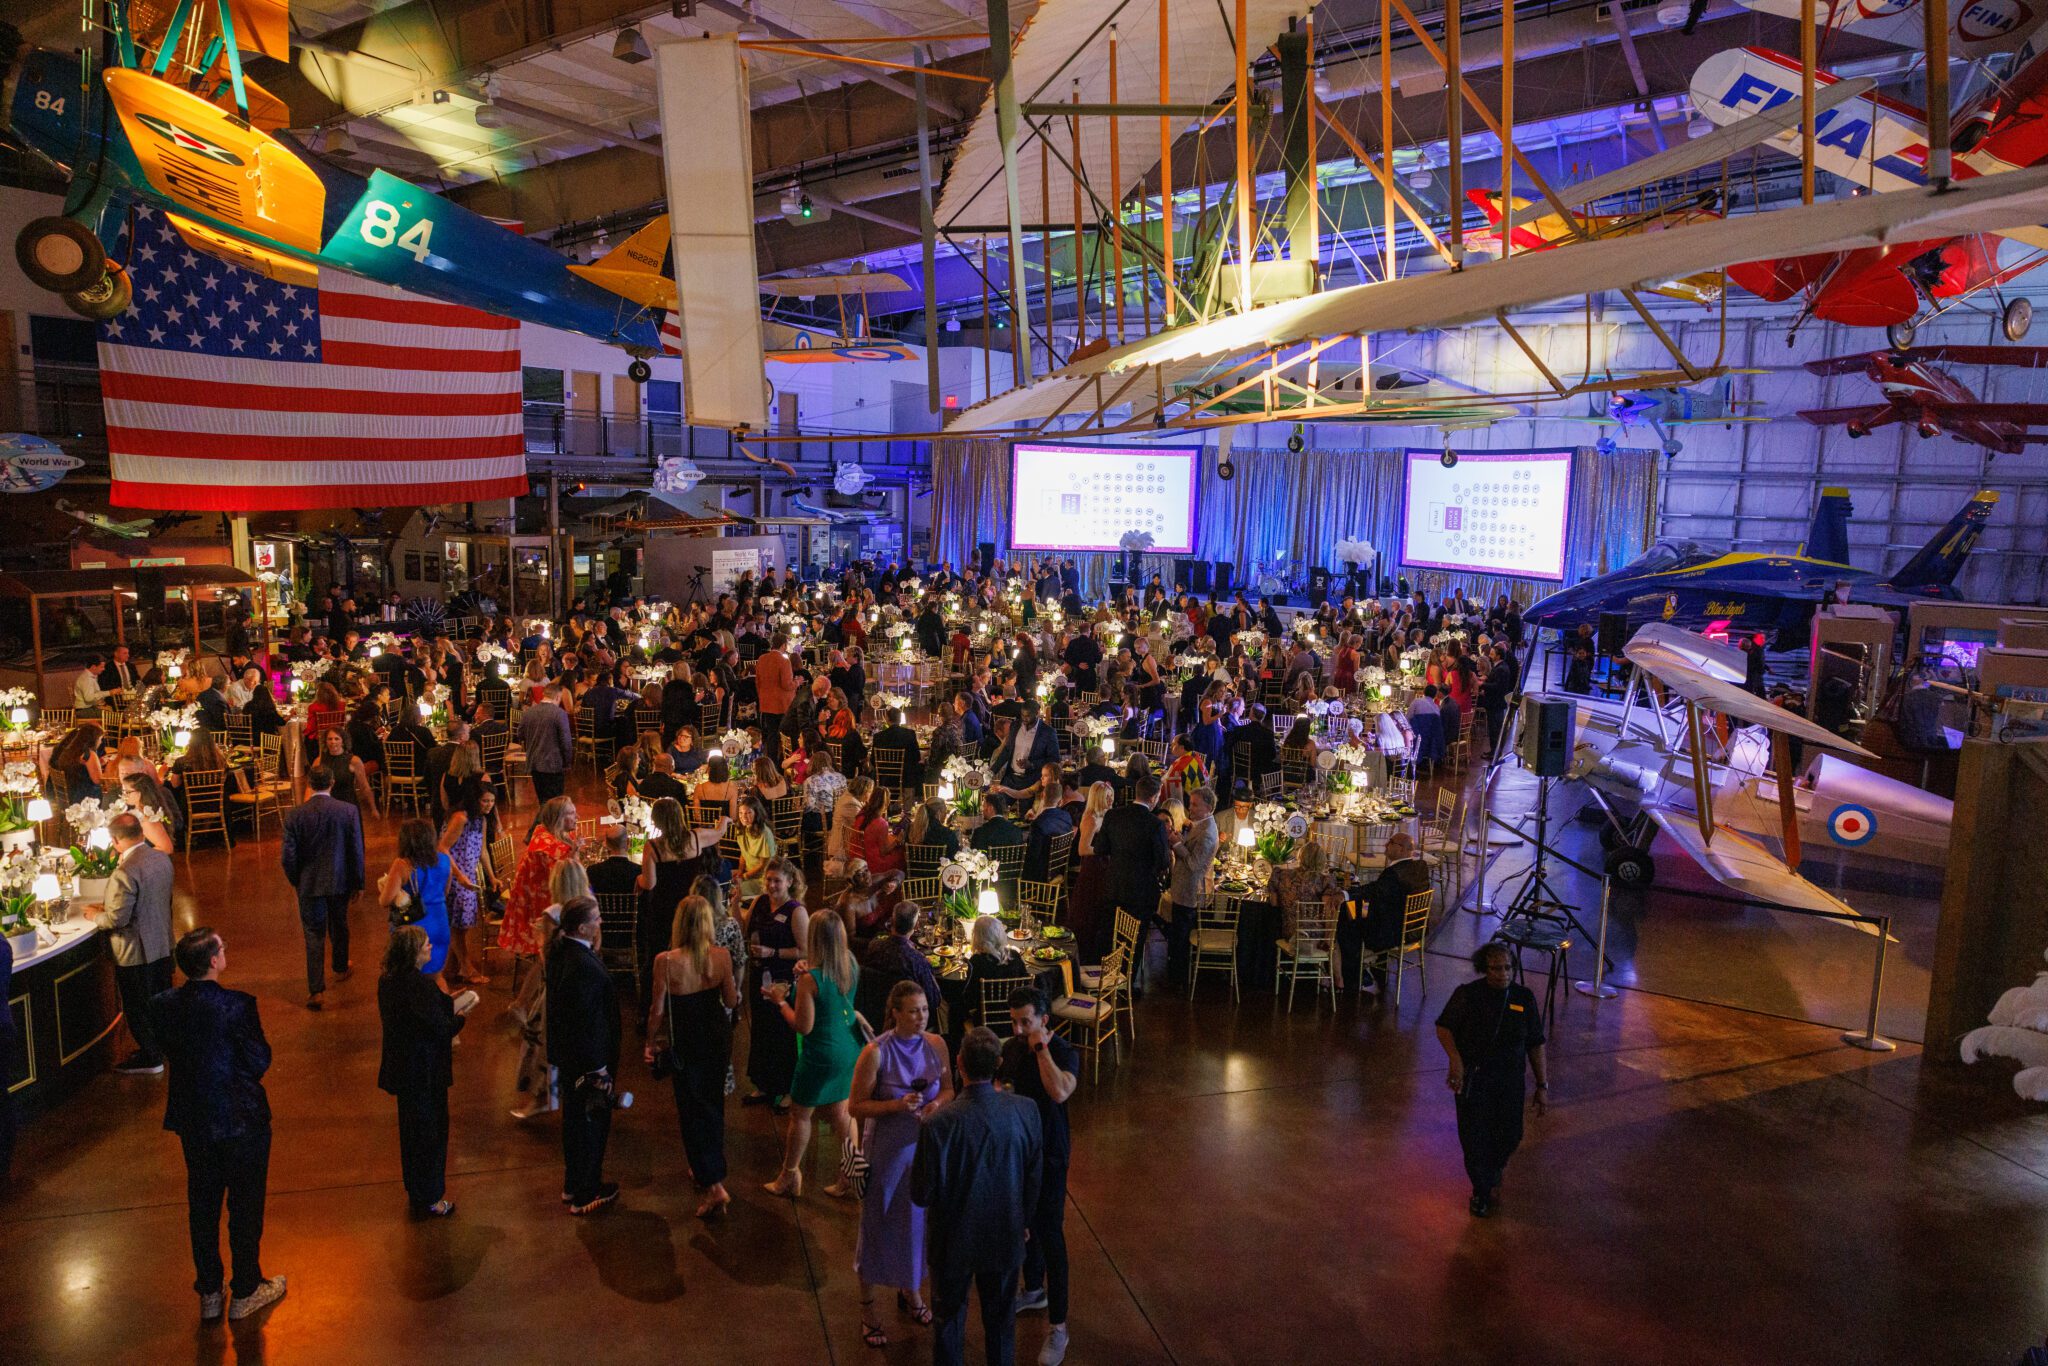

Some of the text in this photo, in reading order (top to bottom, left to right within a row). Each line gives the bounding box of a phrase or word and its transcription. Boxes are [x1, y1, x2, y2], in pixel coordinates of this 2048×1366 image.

[1965, 5, 2014, 30] FINA
[34, 89, 65, 116] 84
[360, 199, 433, 263] 84
[18, 457, 49, 466] World
[51, 459, 72, 467] War
[1939, 524, 1968, 559] 4
[1703, 600, 1746, 620] Blue Angels
[872, 699, 880, 707] 35
[1077, 727, 1086, 735] 36
[725, 746, 736, 755] 41
[967, 778, 979, 787] 42
[1290, 825, 1302, 834] 43
[946, 874, 962, 885] 47
